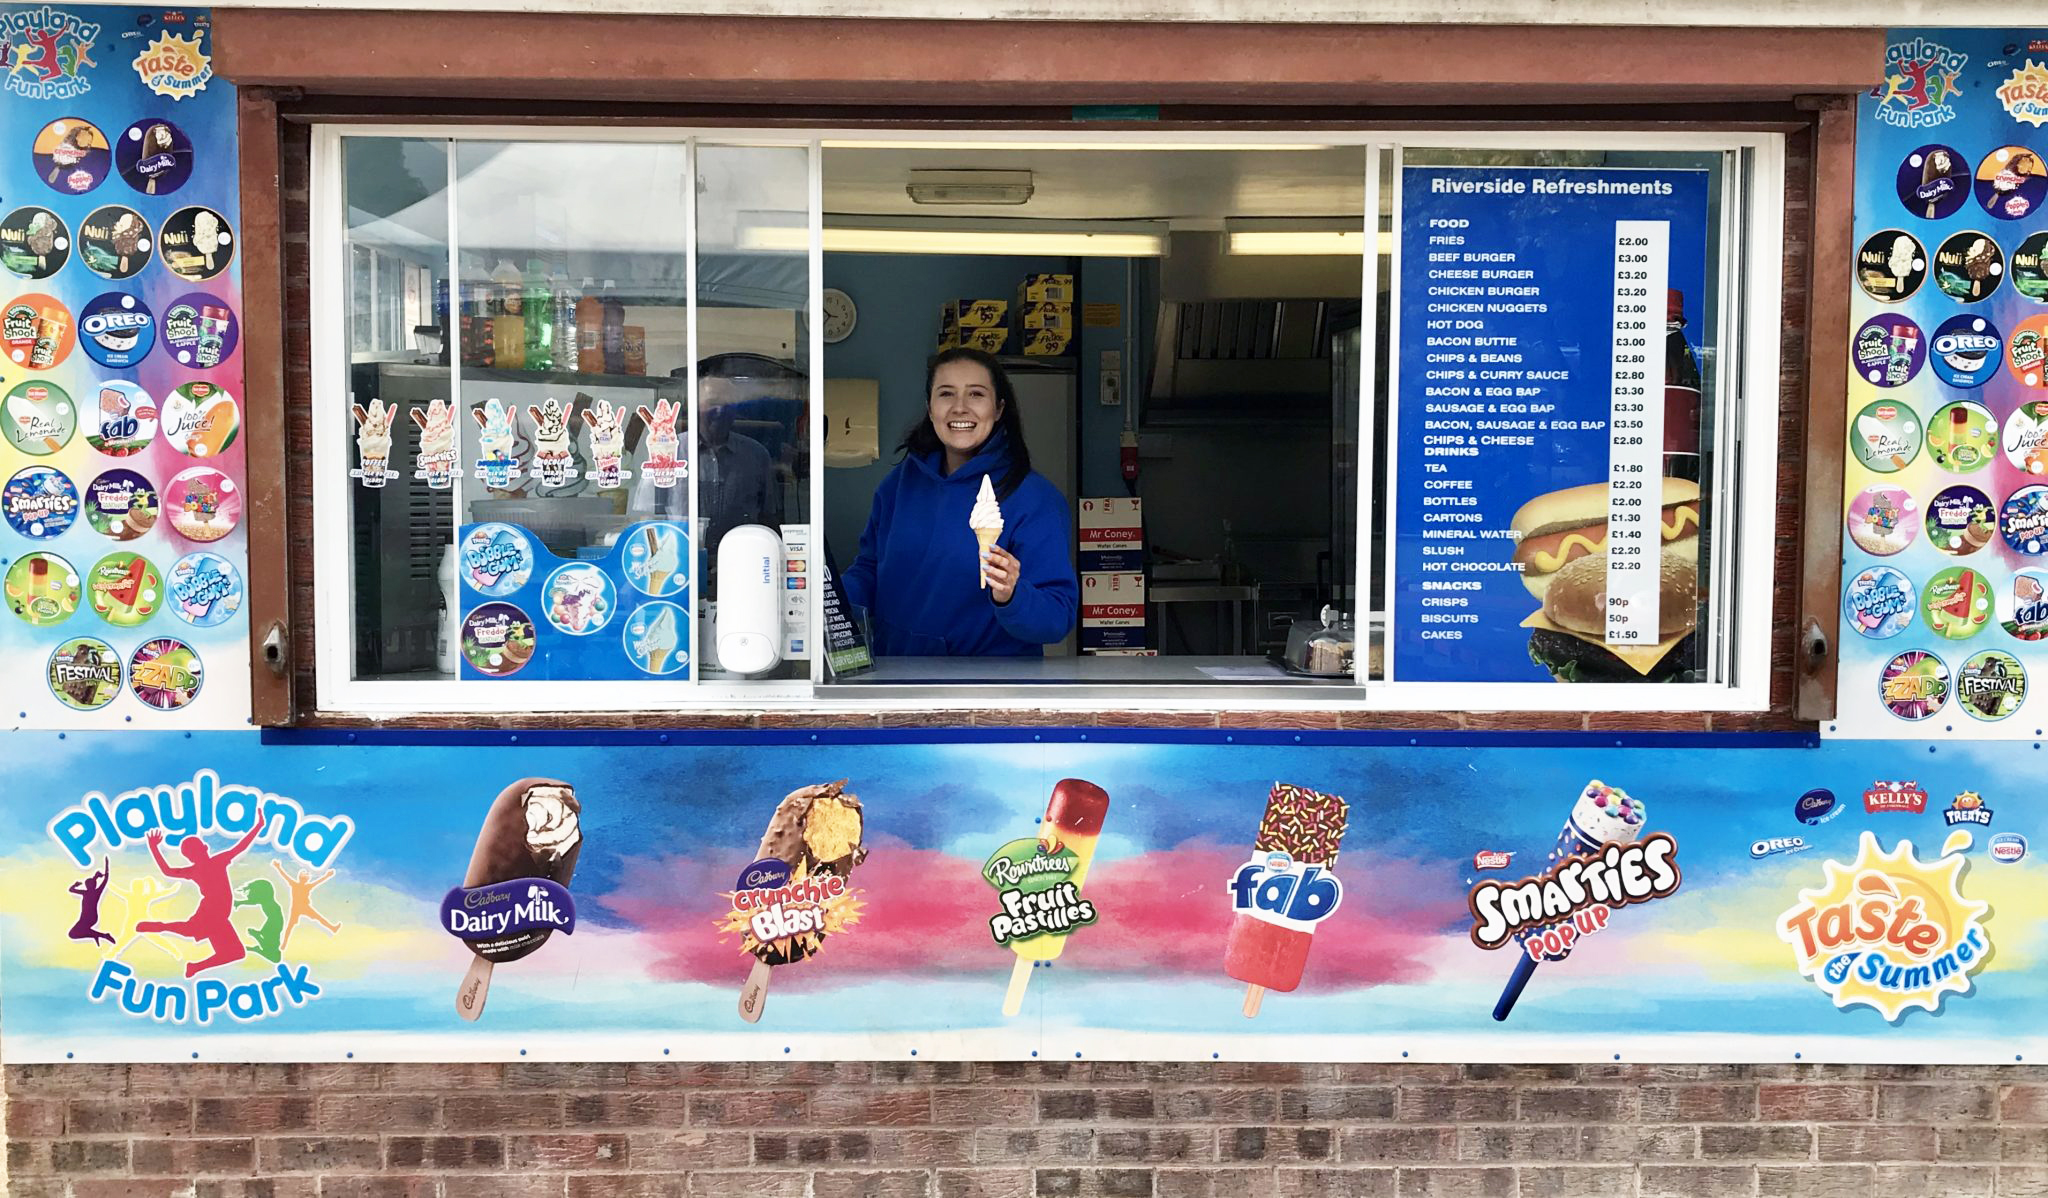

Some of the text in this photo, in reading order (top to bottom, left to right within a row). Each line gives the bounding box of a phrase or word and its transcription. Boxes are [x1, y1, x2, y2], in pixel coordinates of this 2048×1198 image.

[136, 55, 194, 77] Taste
[164, 67, 211, 89] Summer
[5, 73, 90, 99] Fun Park
[1875, 104, 1956, 128] Fun Park
[140, 158, 173, 174] Dairy Milk
[1431, 177, 1673, 195] Riverside Refreshments
[1429, 218, 1470, 229] FOOD
[1429, 235, 1465, 245] FRIES
[1618, 237, 1649, 246] £2.00
[1428, 252, 1516, 262] BEEF BURGER
[1618, 254, 1648, 263] £3.00
[1428, 269, 1534, 279] CHEESE BURGER
[1617, 271, 1648, 280] £3.20
[1428, 286, 1540, 296] CHICKEN BURGER
[1617, 287, 1647, 297] £3.20
[1427, 303, 1548, 313] CHICKEN NUGGETS
[1616, 304, 1647, 313] £3.00
[4, 317, 32, 329] Fruit
[84, 314, 149, 333] OREO
[167, 317, 193, 329] Fruit
[1427, 320, 1484, 330] HOT DOG
[1616, 321, 1646, 330] £3.00
[4, 327, 36, 339] Shoot
[167, 327, 197, 339] Shoot
[1426, 336, 1517, 347] BACON BUTTIE
[1616, 338, 1646, 347] £3.00
[1936, 336, 1997, 352] OREO
[1045, 342, 1059, 354] 99
[1426, 353, 1523, 363] CHIPS & BEANS
[1615, 354, 1645, 363] £2.80
[1425, 370, 1569, 380] CHIPS & CURRY SAUCE
[1615, 371, 1645, 380] £2.80
[1425, 387, 1541, 397] BACON & EGG BAP
[1614, 386, 1644, 396] £3.30
[1425, 403, 1555, 413] SAUSAGE & EGG BAP
[1614, 403, 1644, 412] £3.30
[30, 416, 55, 430] Real
[100, 416, 139, 439] fab
[167, 416, 215, 436] Juice!
[1424, 420, 1606, 431] BACON, SAUSAGE & EGG BAP
[1613, 420, 1644, 429] £3.50
[16, 423, 66, 443] Lemonade
[1423, 435, 1535, 446] CHIPS & CHEESE
[1613, 436, 1643, 445] £2.80
[1424, 447, 1479, 457] DRINKS
[1424, 463, 1448, 473] TEA
[1613, 464, 1643, 473] £1.80
[92, 482, 121, 492] Dairy Milk
[1423, 480, 1473, 490] COFFEE
[1612, 480, 1642, 489] £2.20
[100, 493, 128, 502] Freddo
[1423, 496, 1478, 506] BOTTLES
[1612, 497, 1642, 507] £2.00
[10, 495, 70, 513] SMARTIES
[1423, 513, 1483, 523] CARTONS
[1611, 513, 1641, 522] £1.30
[1090, 529, 1133, 540] Mr Coney
[1422, 529, 1523, 540] MINERAL WATER
[1611, 530, 1642, 539] £1.40
[466, 543, 517, 569] BUBBLE
[1422, 546, 1465, 556] SLUSH
[1611, 546, 1641, 555] £2.20
[487, 556, 520, 576] GUM
[1422, 562, 1527, 572] HOT CHOCOLATE
[1611, 562, 1641, 570] £2.20
[173, 568, 225, 600] BUBBLE
[1422, 581, 1482, 591] SNACKS
[196, 579, 228, 606] GUM
[1421, 597, 1469, 607] CRISPS
[1608, 597, 1629, 608] 90p
[794, 609, 805, 617] Pay
[1092, 606, 1137, 617] Mr Coney
[1421, 614, 1479, 623] BISCUITS
[1609, 614, 1629, 624] 50p
[1421, 630, 1463, 640] CAKES
[1609, 630, 1638, 639] £1.50
[55, 663, 115, 684] FESTIVAL
[131, 662, 199, 691] ZZAPP
[1802, 797, 1832, 810] Cadbury
[1868, 791, 1923, 806] KELLY'S
[51, 772, 351, 870] Playland
[1946, 809, 1991, 824] TREATS
[1751, 837, 1803, 856] OREO
[746, 870, 786, 888] Cadbury
[733, 876, 845, 911] crunchie
[1230, 864, 1340, 922] fab
[1475, 837, 1676, 943] SMARTIES
[464, 889, 511, 909] Cadbury
[1001, 883, 1077, 918] Fruit
[451, 900, 562, 935] Dairy Milk
[752, 903, 825, 941] Blast
[991, 902, 1093, 941] Pastilles
[1525, 904, 1609, 960] POP UP
[1786, 899, 1939, 959] Taste
[1858, 928, 1984, 990] Summer
[1829, 955, 1852, 979] the
[90, 960, 321, 1023] Fun Park
